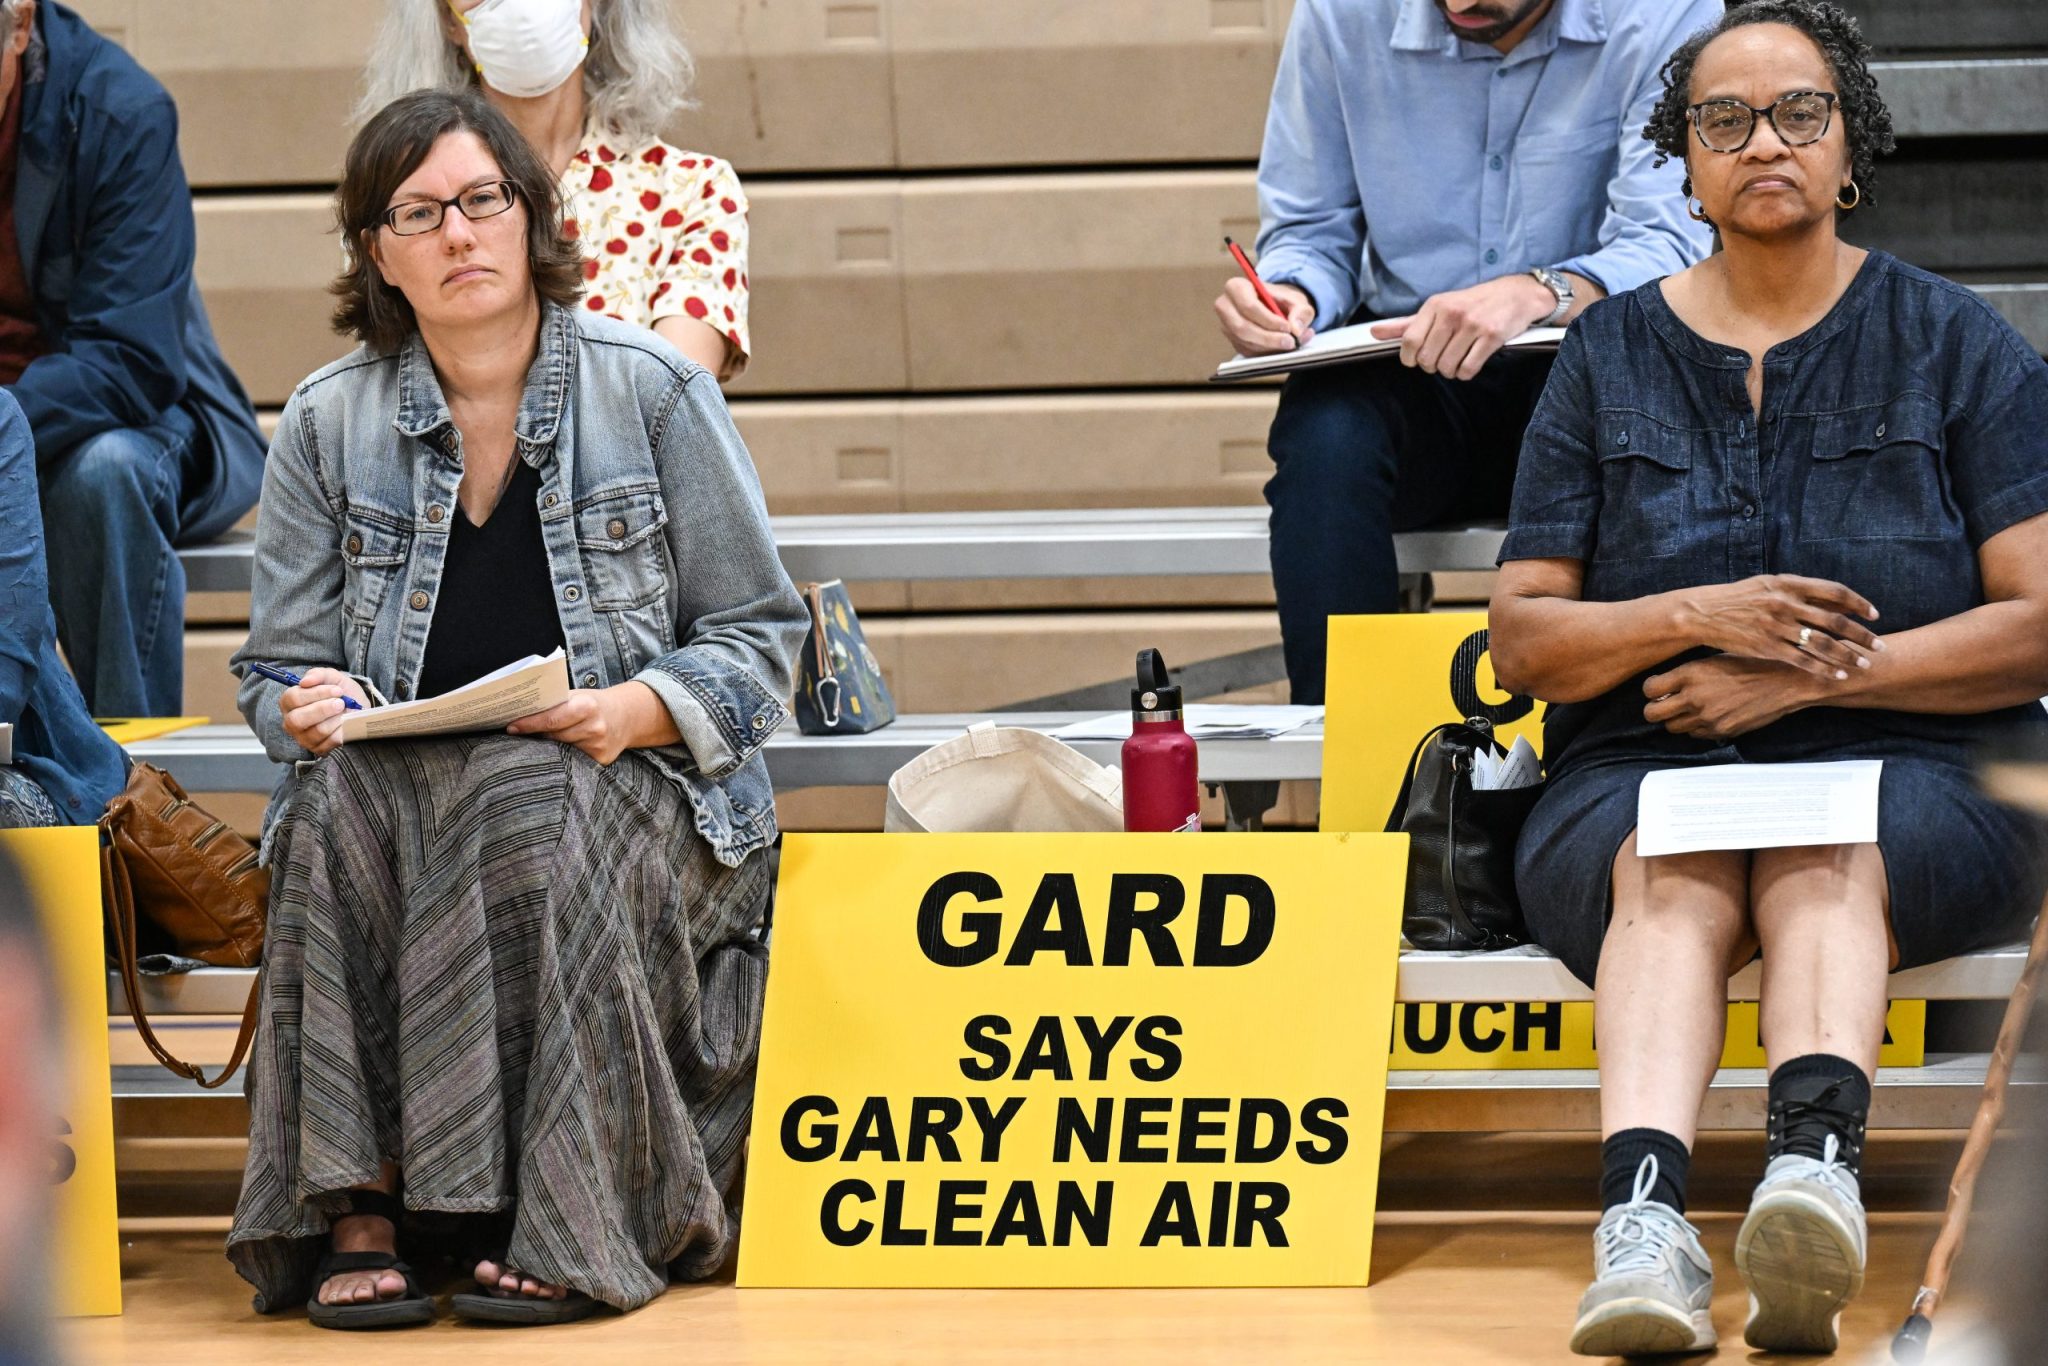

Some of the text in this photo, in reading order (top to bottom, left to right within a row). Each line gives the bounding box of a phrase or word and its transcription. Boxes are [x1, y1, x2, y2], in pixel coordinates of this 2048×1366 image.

[916, 871, 1276, 968] GARD
[959, 1014, 1183, 1082] SAYS
[1390, 1001, 1562, 1055] UCH
[780, 1095, 1349, 1165] GARY NEEDS
[820, 1178, 1291, 1248] CLEAN AIR
